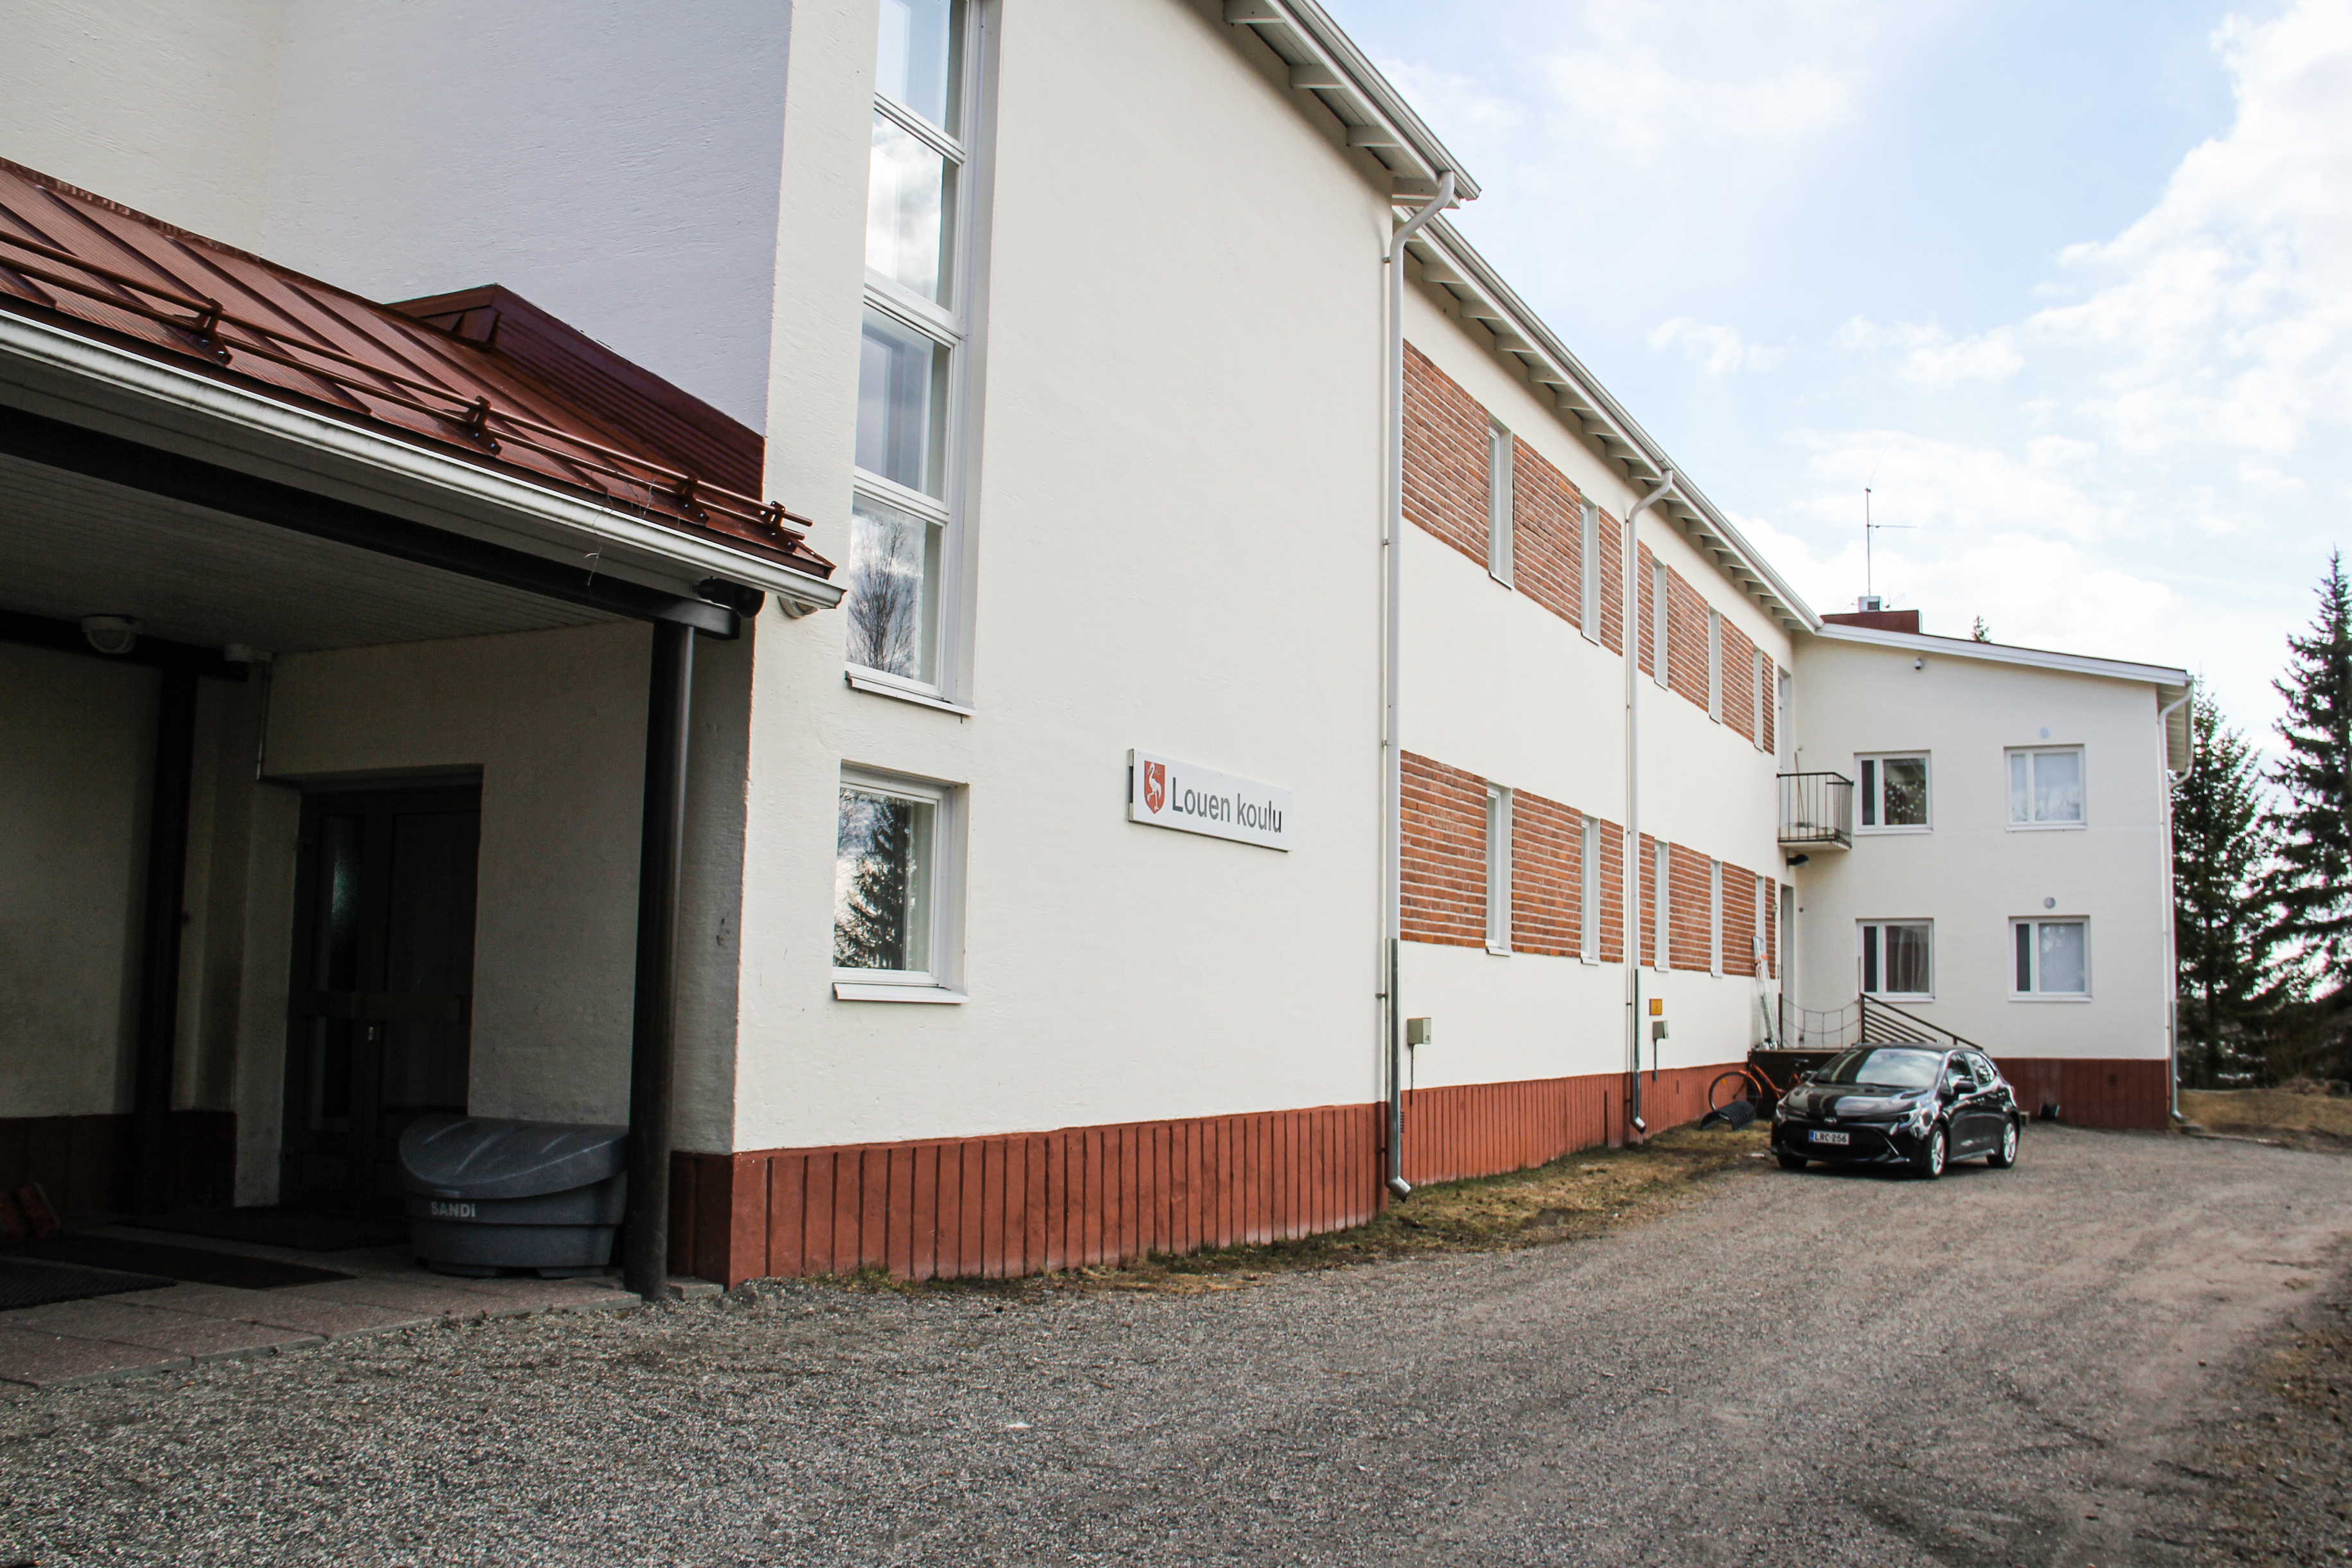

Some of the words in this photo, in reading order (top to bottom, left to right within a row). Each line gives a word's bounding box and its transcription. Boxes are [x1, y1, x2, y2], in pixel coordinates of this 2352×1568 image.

[1172, 777, 1231, 823] Louen
[1237, 793, 1282, 833] koulu
[1814, 1132, 1848, 1143] LRC-256
